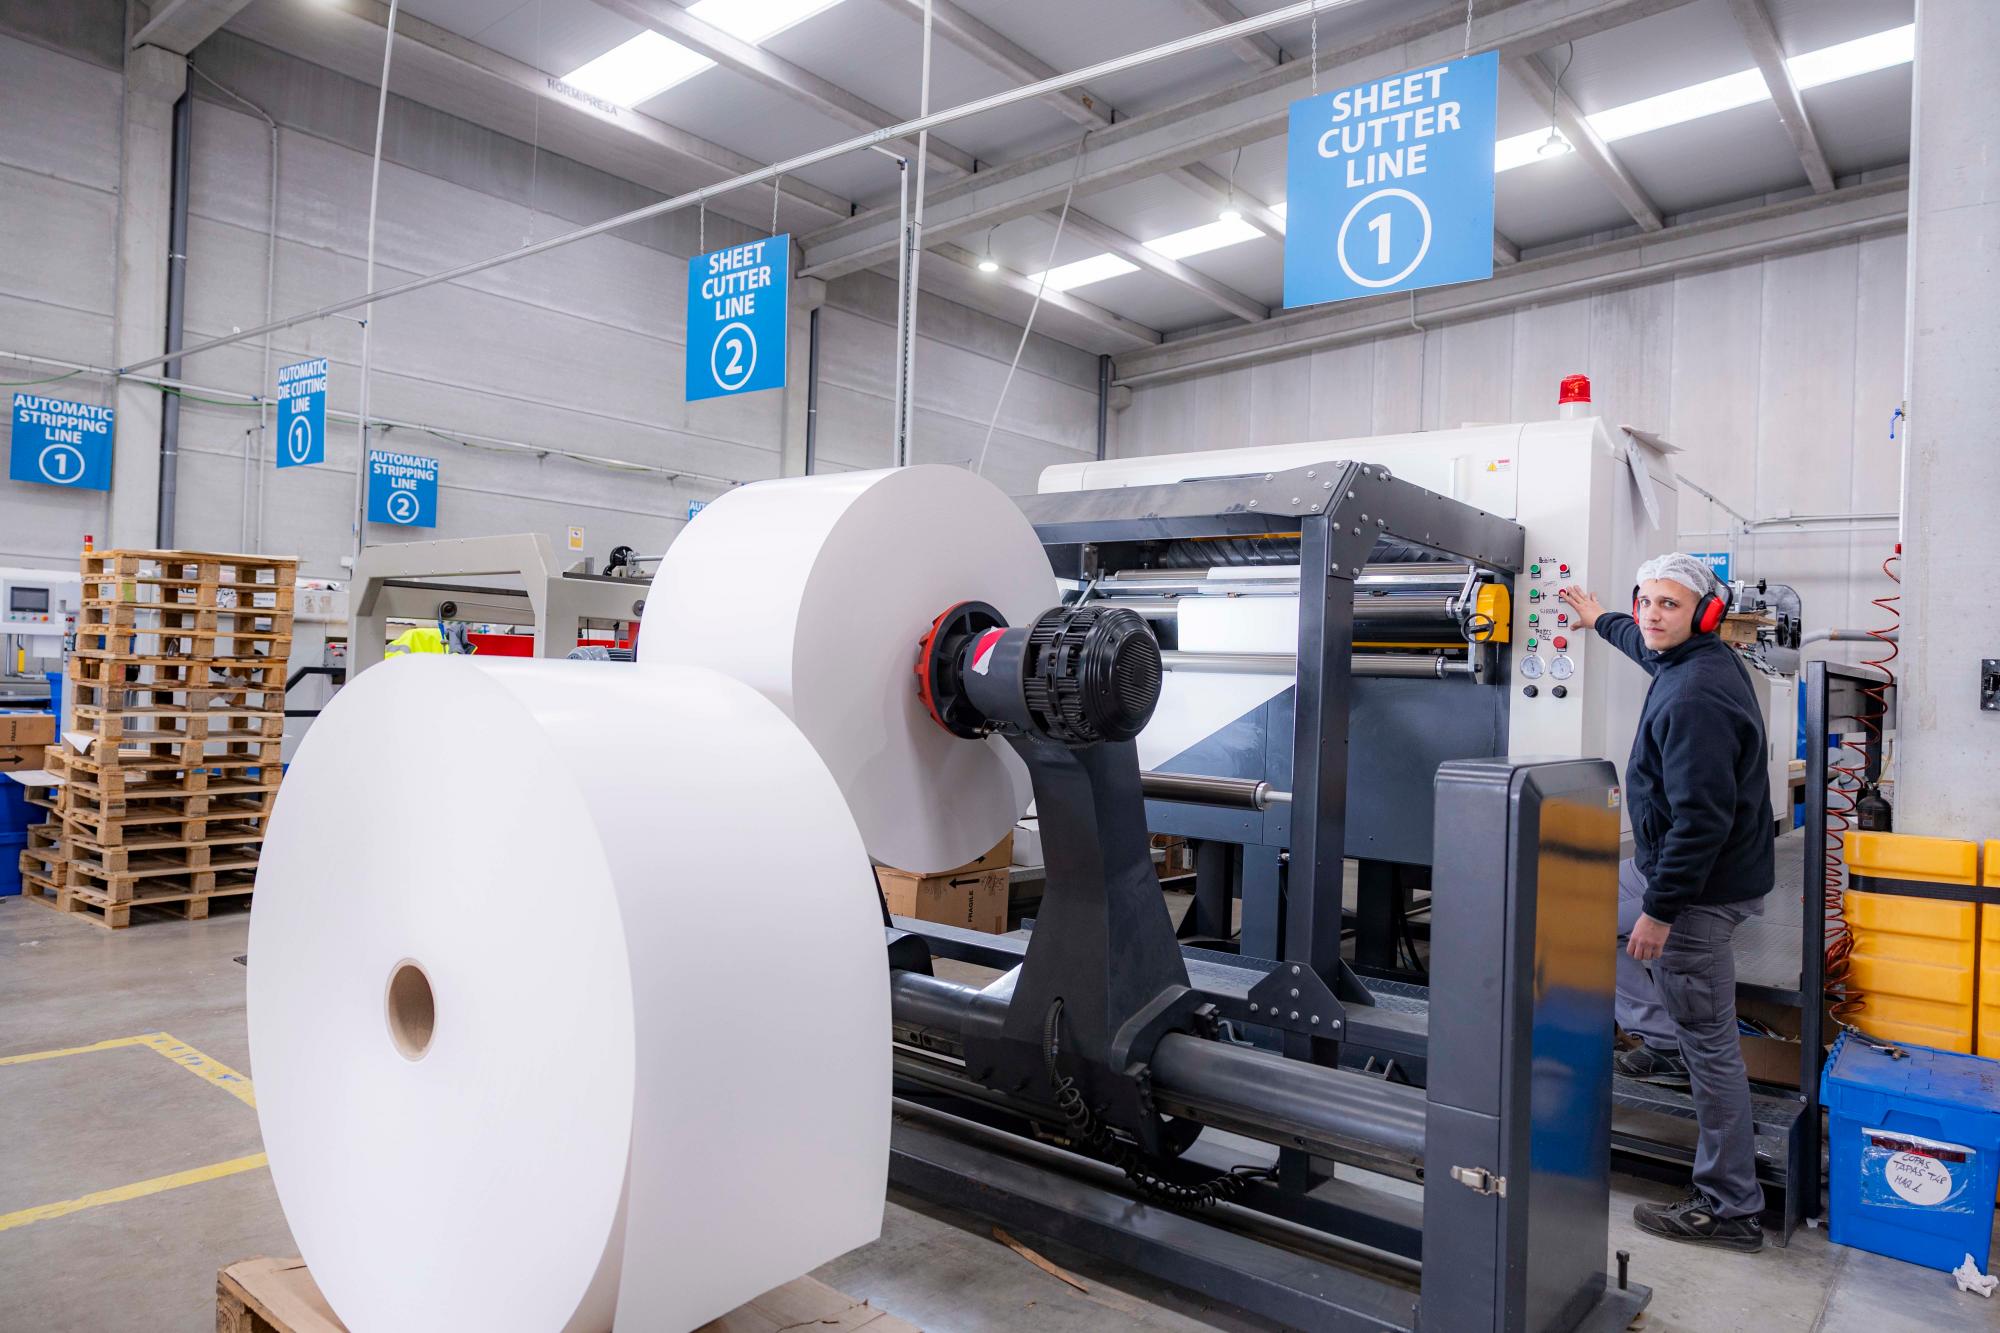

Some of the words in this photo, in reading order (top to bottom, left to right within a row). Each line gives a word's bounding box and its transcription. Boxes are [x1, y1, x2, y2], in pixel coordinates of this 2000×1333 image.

[1332, 66, 1449, 123] SHEET
[1317, 101, 1461, 159] CUTTER
[1346, 143, 1427, 189] LINE
[1368, 212, 1392, 265] 1
[709, 242, 766, 275] SHEET
[701, 265, 771, 300] CUTTER
[715, 293, 755, 321] LINE
[725, 338, 743, 376] 2
[278, 359, 328, 384] AUTOMATIC
[278, 382, 291, 401] DIE
[291, 377, 326, 398] CUTTING
[14, 394, 114, 422] AUTOMATIC
[291, 397, 311, 414] LINE
[19, 409, 108, 434] STRIPPING
[45, 427, 82, 444] LINE
[295, 426, 303, 453] 1
[54, 453, 67, 475] 1
[370, 451, 439, 470] AUTOMATIC
[373, 463, 435, 481] STRIPPING
[391, 476, 417, 490] LINE
[396, 498, 410, 517] 2
[1893, 1160, 1926, 1177] TAPAS
